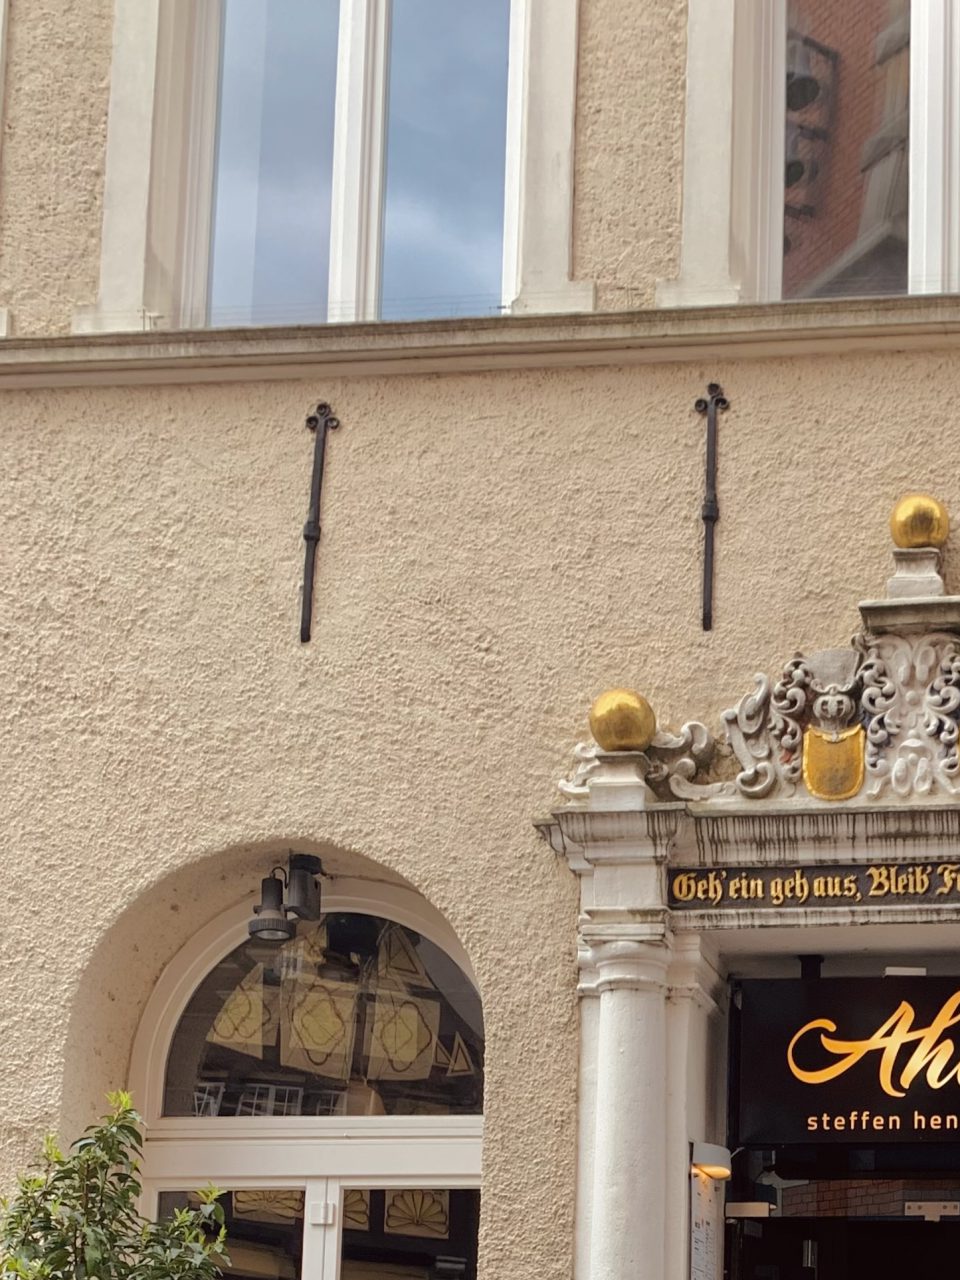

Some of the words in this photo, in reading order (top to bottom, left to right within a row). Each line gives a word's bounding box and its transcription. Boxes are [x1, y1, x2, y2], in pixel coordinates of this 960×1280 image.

[672, 870, 727, 905] Geh'
[728, 872, 764, 899] ein
[770, 869, 810, 905] geh
[813, 873, 862, 901] aus,
[807, 1111, 901, 1130] steffen
